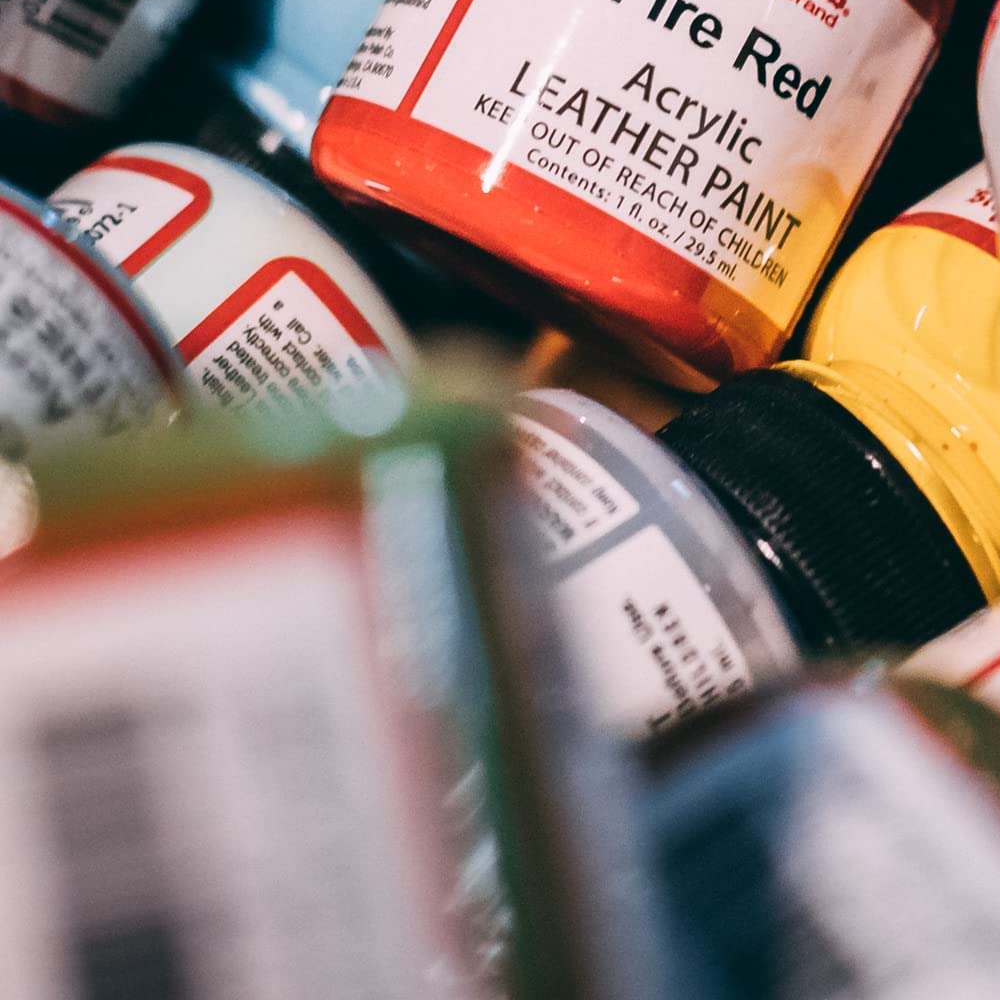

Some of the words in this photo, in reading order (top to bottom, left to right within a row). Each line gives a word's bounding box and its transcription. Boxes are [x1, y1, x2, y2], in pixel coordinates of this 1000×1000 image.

[622, 62, 762, 164] Acrylic
[733, 26, 832, 118] Red
[474, 94, 521, 129] KEE
[531, 121, 581, 156] OUT
[583, 148, 615, 173] OF
[616, 166, 688, 219] REACH
[690, 209, 718, 235] OF
[718, 227, 789, 289] CHILDREN
[509, 60, 700, 187] LEATHER
[701, 164, 801, 250] PAINT
[527, 148, 611, 202] Contents:
[616, 195, 625, 210] 1
[629, 202, 643, 222] fl.
[648, 217, 670, 239] oz.
[684, 235, 717, 265] 29.5
[717, 259, 737, 281] ml.
[258, 314, 283, 341] with
[286, 318, 312, 345] Call
